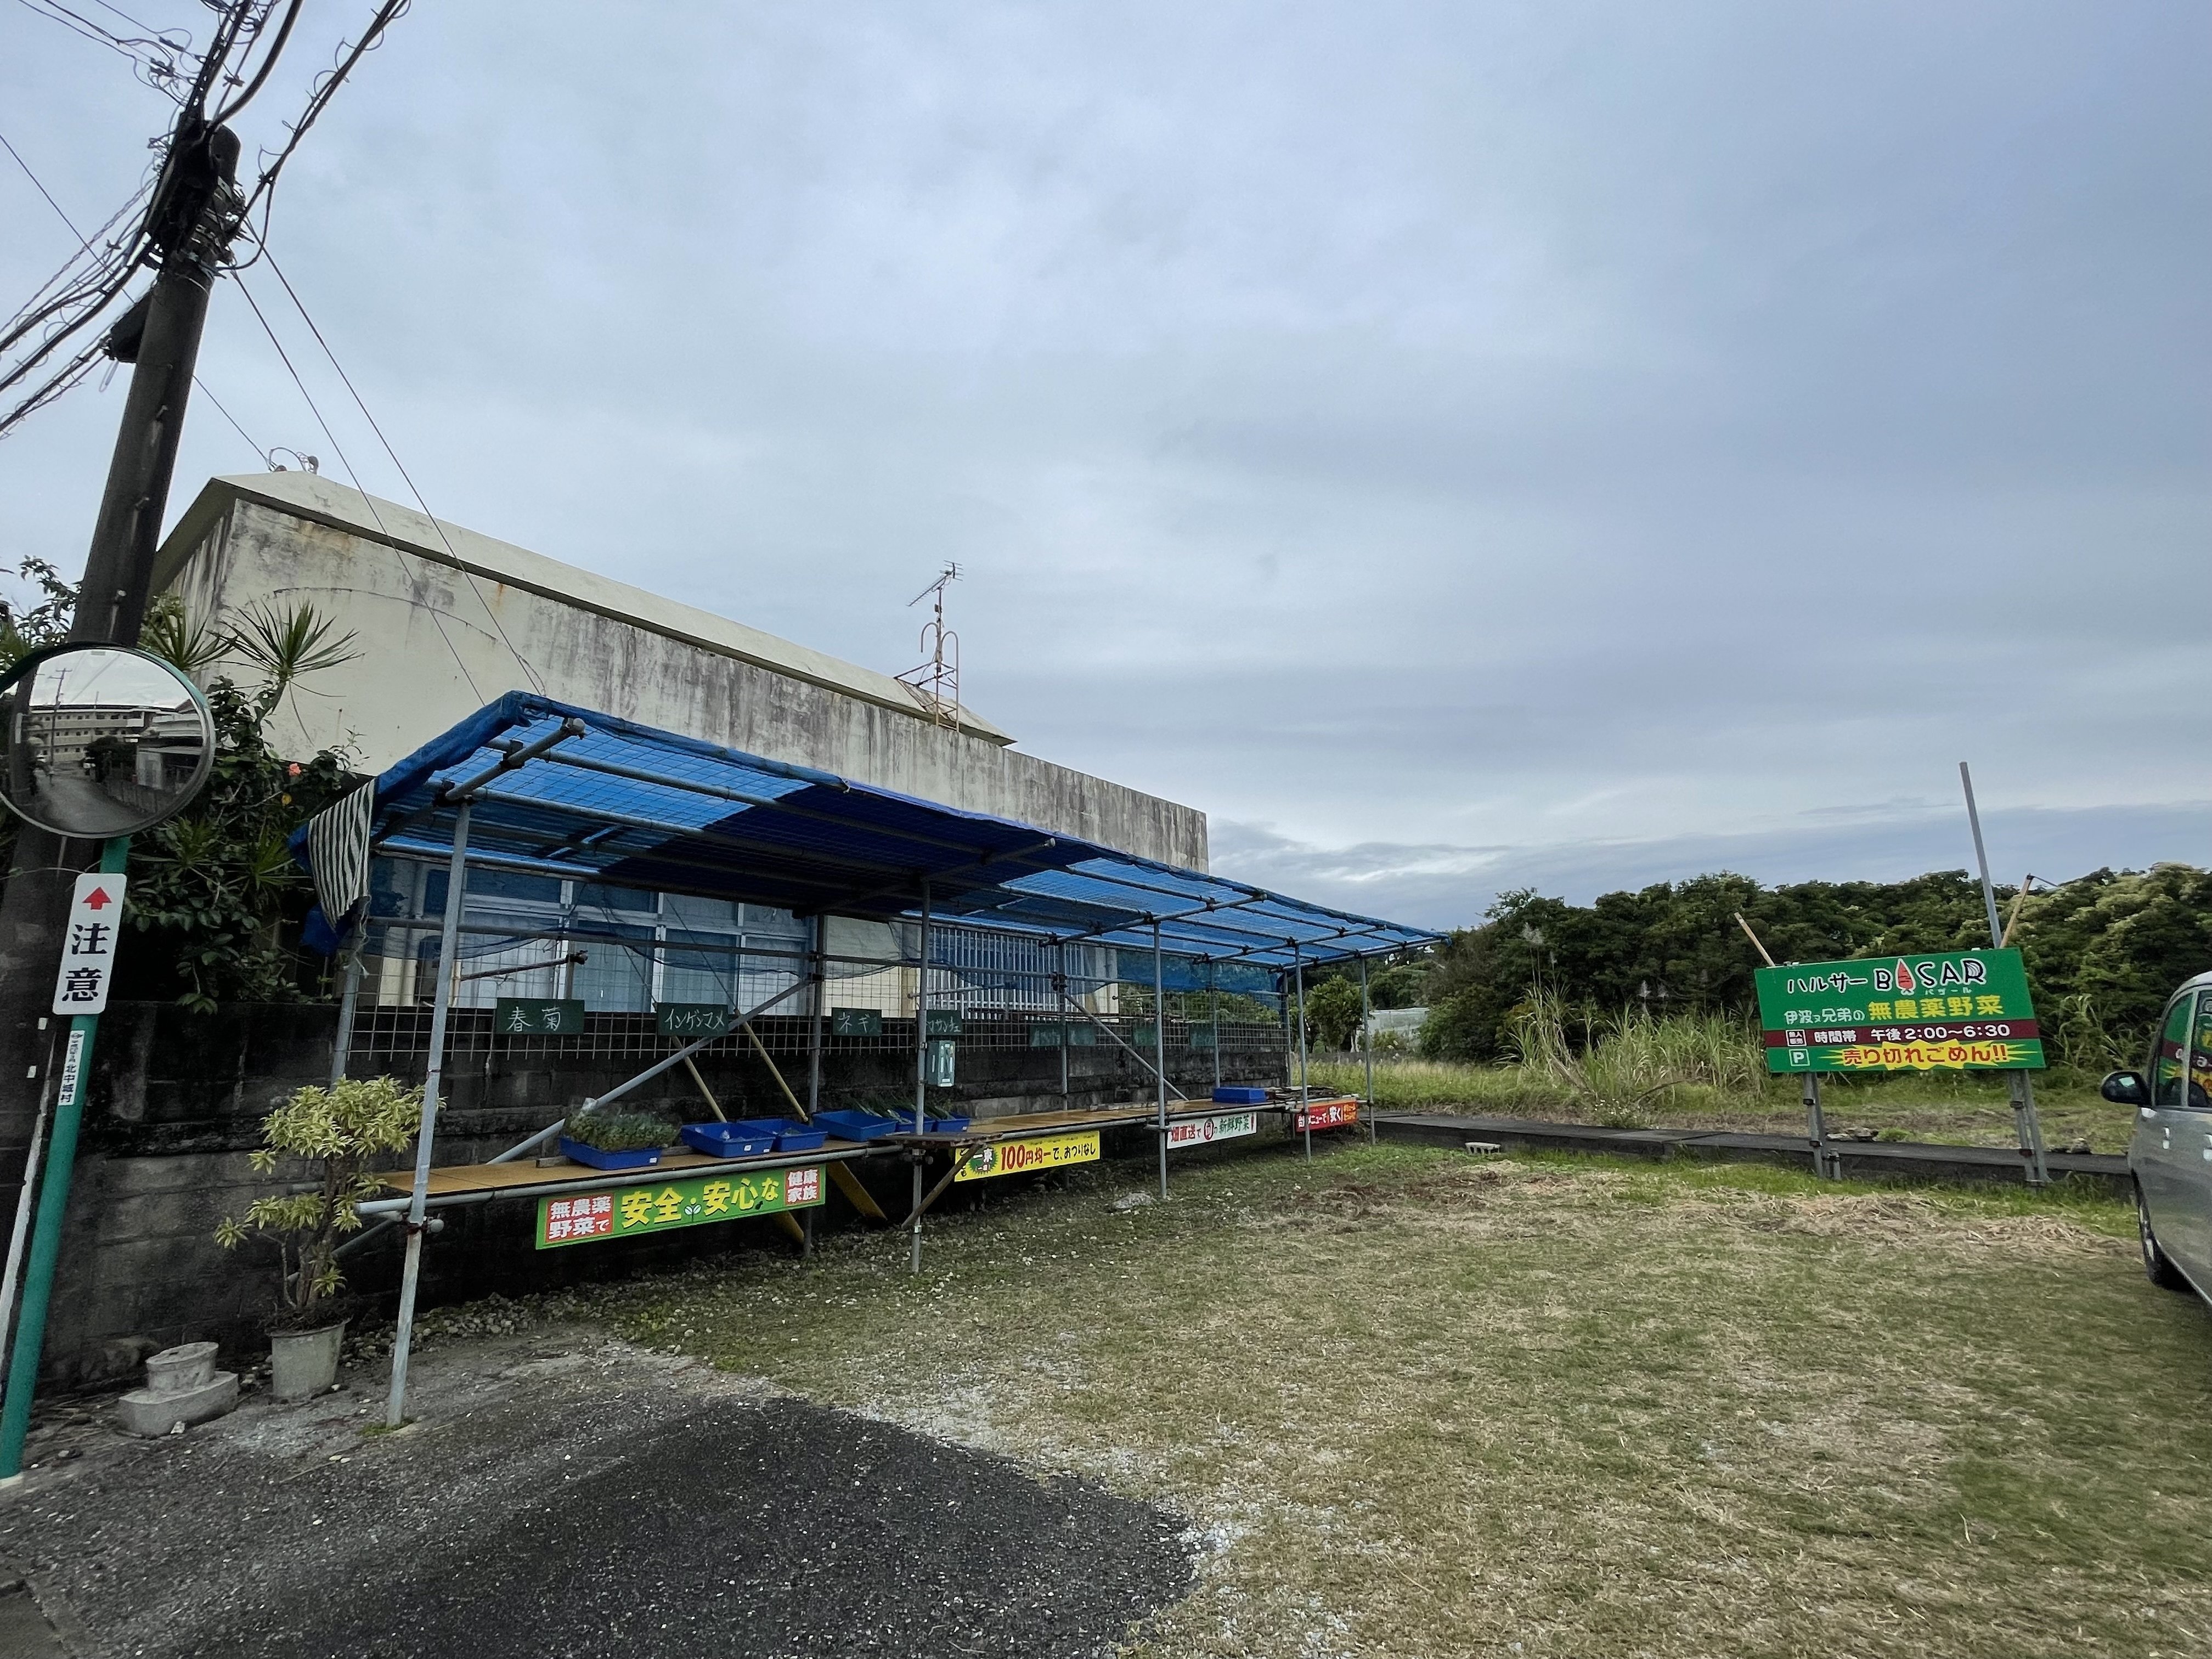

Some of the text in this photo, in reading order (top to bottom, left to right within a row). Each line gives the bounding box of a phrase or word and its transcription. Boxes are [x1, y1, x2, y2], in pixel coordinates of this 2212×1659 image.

[62, 923, 111, 1001] 注意
[1787, 972, 1868, 994] ハルサー
[1868, 995, 2004, 1020] 無農薬野菜
[506, 1006, 561, 1032] 春菊
[664, 1008, 725, 1031] インゲンマメ
[838, 1012, 871, 1034] ネギ
[1814, 1029, 1857, 1043] 時間帯
[1793, 1052, 1805, 1064] P
[787, 1169, 819, 1188] 健康
[787, 1185, 817, 1204] 家族
[550, 1195, 611, 1220] 無農薬
[549, 1216, 610, 1240] 野菜で
